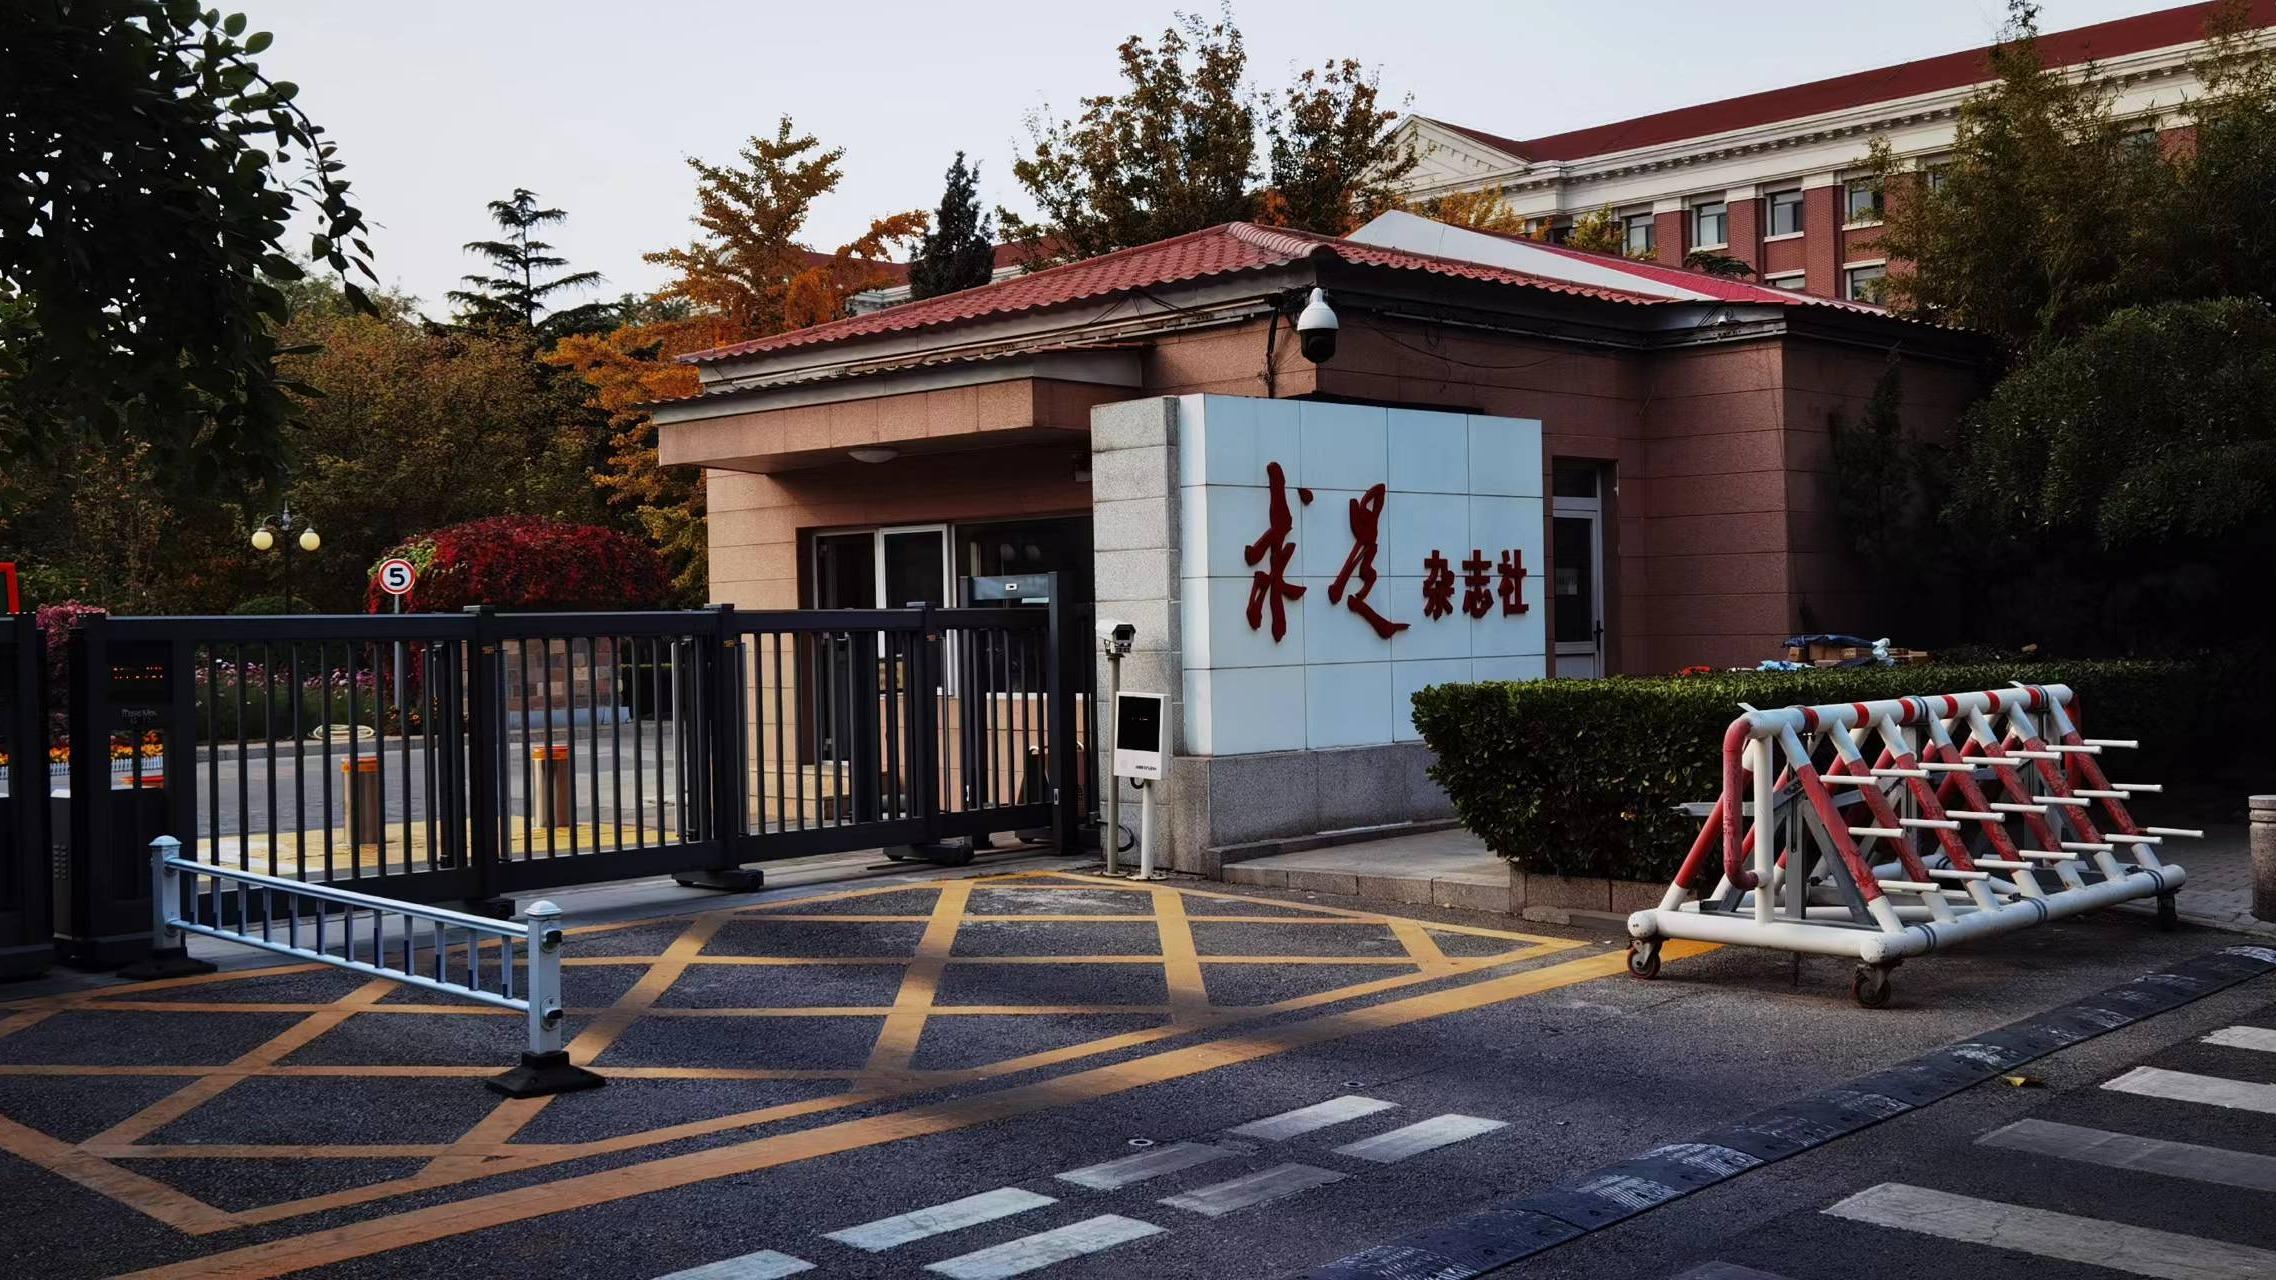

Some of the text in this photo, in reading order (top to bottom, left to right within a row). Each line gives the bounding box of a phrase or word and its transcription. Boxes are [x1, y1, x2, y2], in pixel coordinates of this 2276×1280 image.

[390, 568, 405, 586] 5
[1245, 462, 1411, 642] 求是
[1422, 549, 1529, 620] 杂志社
